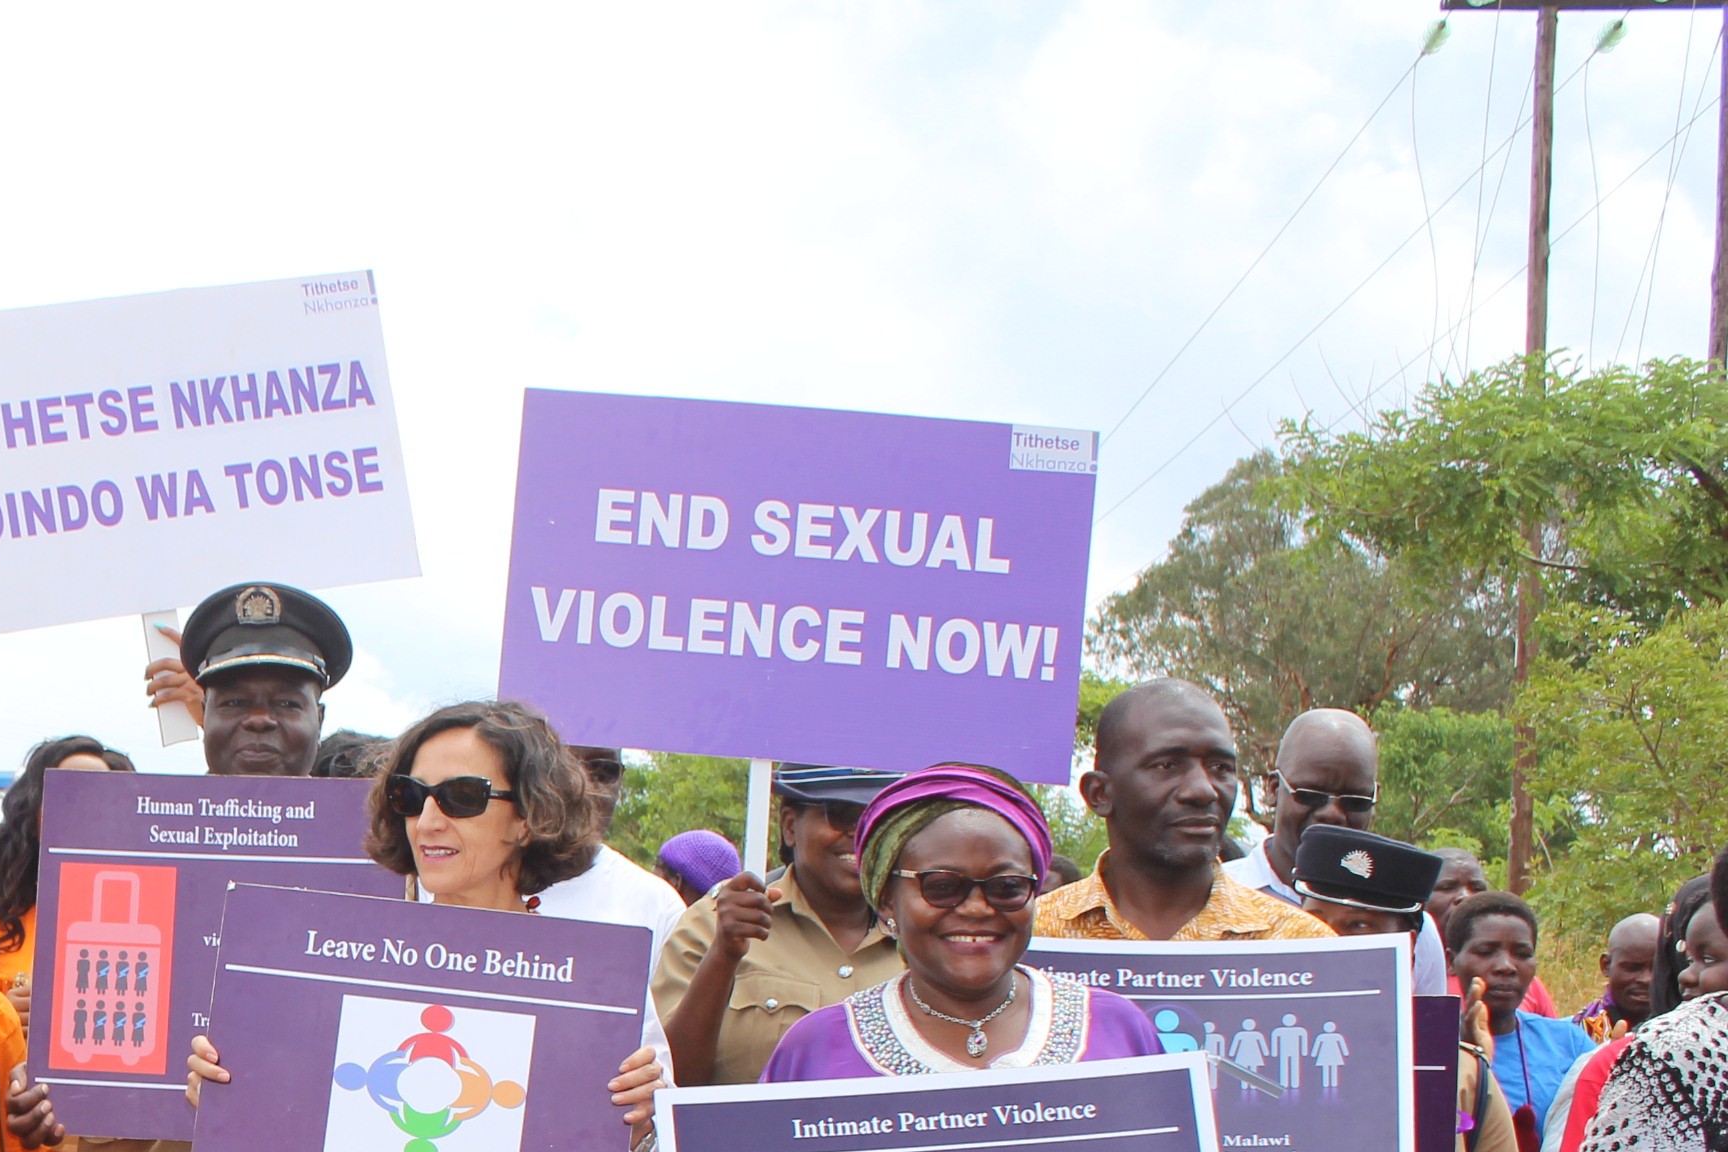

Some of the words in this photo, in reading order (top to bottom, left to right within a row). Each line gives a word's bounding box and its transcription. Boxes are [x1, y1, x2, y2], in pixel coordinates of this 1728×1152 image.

[301, 278, 359, 297] Tithetse
[169, 360, 376, 430] NKHANZA
[1012, 432, 1080, 452] Tithetse
[135, 468, 215, 522] WA
[224, 446, 384, 509] TONSE
[594, 488, 729, 551] END
[750, 500, 1010, 574] SEXUAL
[530, 586, 866, 666] VIOLENCE
[886, 614, 1059, 682] NOW!
[136, 797, 194, 816] Human
[199, 799, 282, 823] Trafficking
[285, 802, 315, 819] and
[150, 825, 200, 844] Sexual
[203, 827, 298, 850] Exploitation
[304, 930, 375, 962] Leave
[382, 938, 418, 966] No
[425, 943, 477, 973] One
[483, 950, 575, 983] Behind
[1117, 969, 1205, 989] Partner
[1210, 968, 1313, 988] Violence
[792, 1112, 893, 1140] Intimate
[898, 1109, 987, 1136] Partner
[993, 1101, 1096, 1129] Violence
[1223, 1134, 1290, 1147] Malawi
